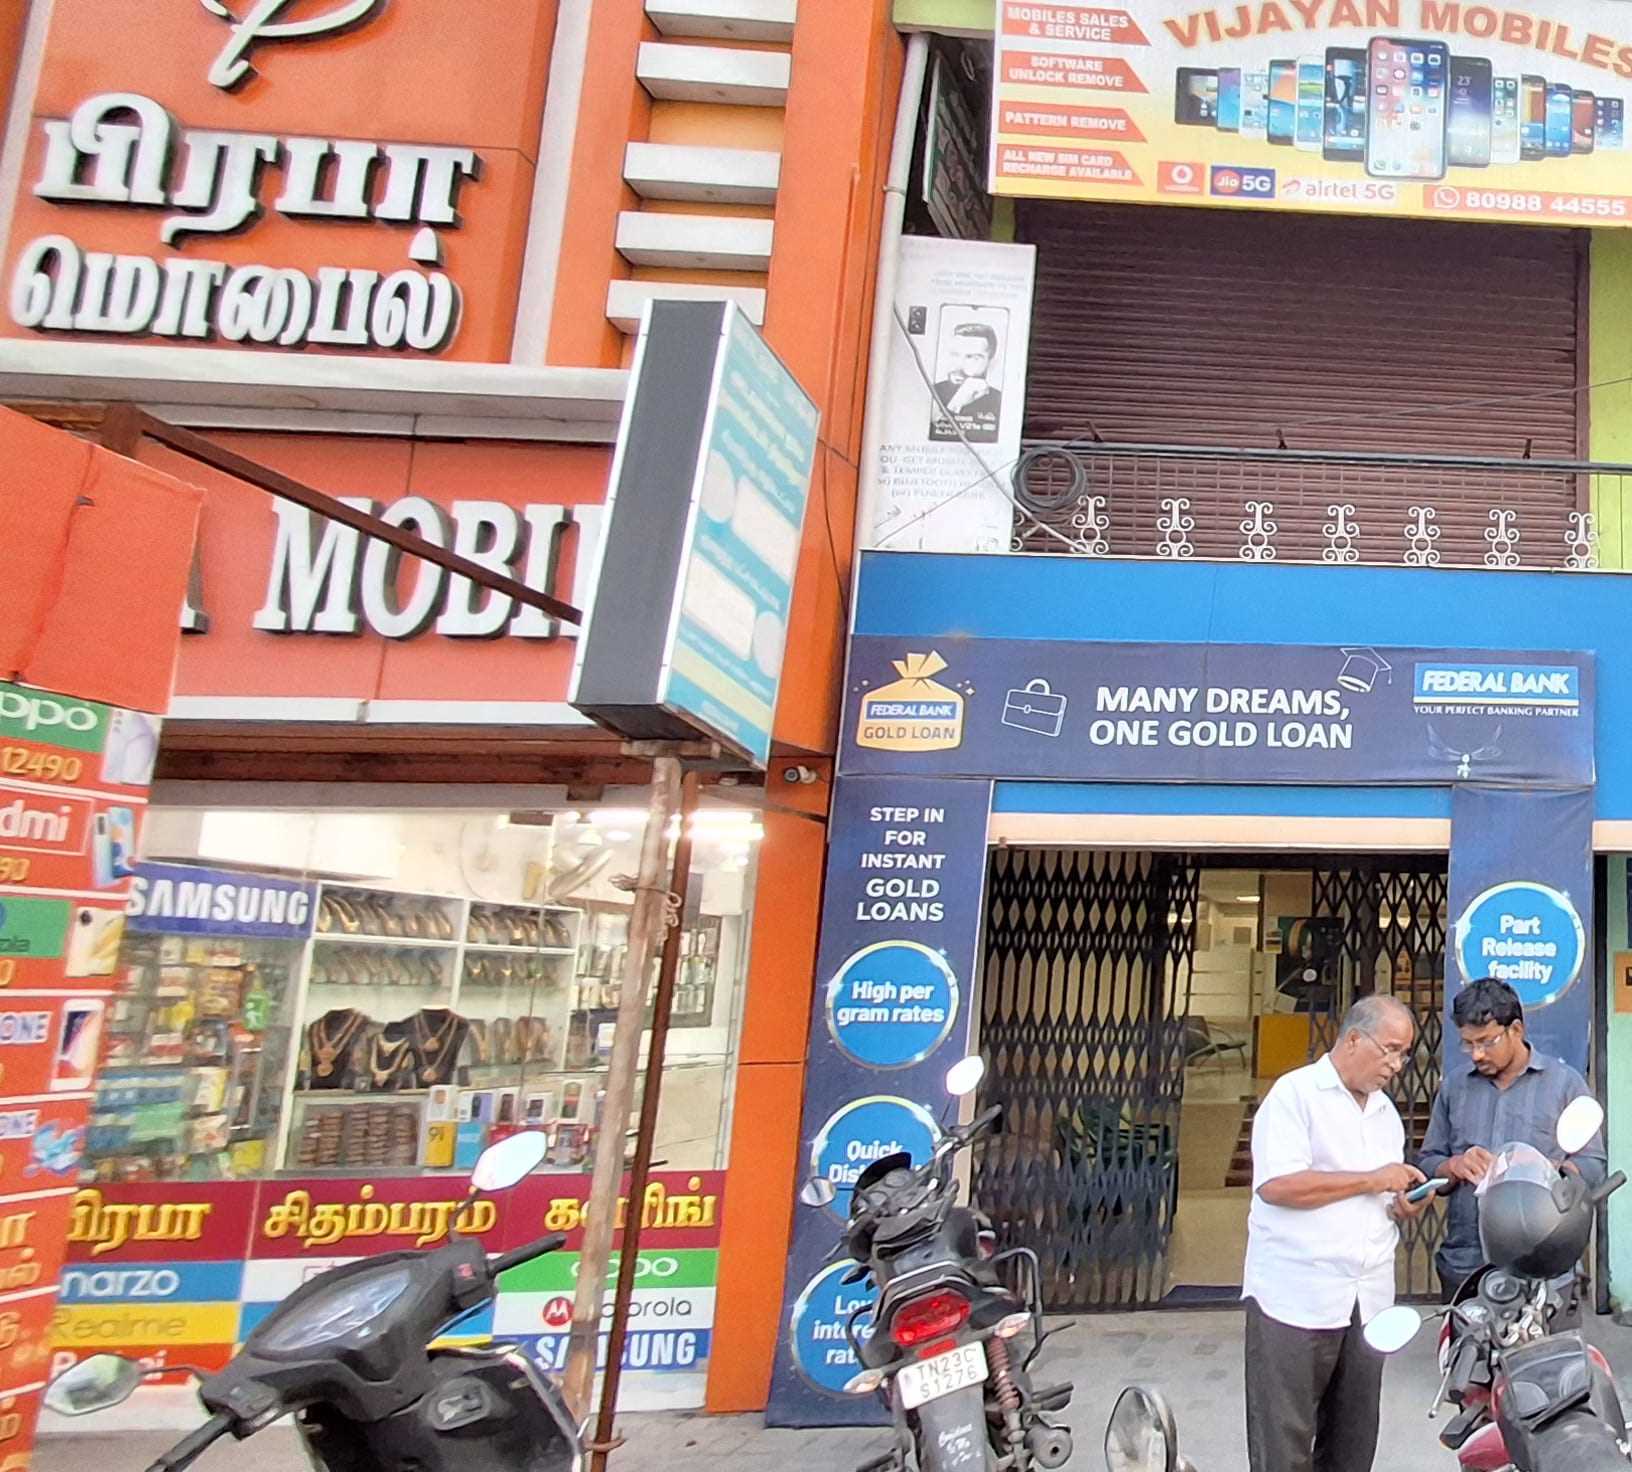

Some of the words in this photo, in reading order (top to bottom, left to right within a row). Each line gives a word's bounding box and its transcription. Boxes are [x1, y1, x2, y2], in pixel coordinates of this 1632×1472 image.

[1007, 6, 1076, 26] MOBILES
[1079, 11, 1129, 29] SALES
[1163, 0, 1400, 48] VIJAYAN
[1030, 24, 1040, 36] &
[1045, 25, 1111, 41] SERVICE
[1031, 56, 1103, 72] SOFTWARE
[1009, 67, 1066, 85] UNLOCK
[1069, 71, 1124, 88] REMOVE
[1006, 111, 1068, 129] PATTERN
[1071, 114, 1126, 131] REMOVE
[33, 93, 478, 244] பிரபா
[1242, 174, 1271, 193] 5G
[1305, 179, 1359, 198] airtel
[1363, 182, 1395, 200] 5G
[1466, 191, 1542, 211] 80988
[1551, 195, 1625, 217] 44555
[11, 228, 461, 351] மொபைல்
[1422, 669, 1507, 692] FEDERAL
[1510, 671, 1570, 695] BANK
[870, 703, 918, 719] FEDERAL
[920, 704, 954, 721] BANK
[1096, 685, 1198, 714] MANY
[1205, 688, 1350, 720] DREAMS,
[1413, 704, 1440, 716] YOUR
[1442, 704, 1481, 717] PERFECT
[1485, 705, 1531, 718] BANKING
[1534, 705, 1579, 718] PARTNER
[863, 724, 905, 742] GOLD
[911, 724, 955, 742] LOAN
[1089, 720, 1159, 747] ONE
[1167, 721, 1259, 748] GOLD
[1267, 722, 1353, 749] LOAN
[870, 807, 918, 822] STEP
[924, 807, 944, 823] IN
[884, 831, 926, 846] FOR
[861, 854, 945, 869] INSTANT
[866, 879, 940, 898] GOLD
[128, 879, 309, 926] SAMSUNG
[856, 902, 944, 921] LOANS
[1500, 915, 1541, 935] Part
[1482, 938, 1557, 958] Release
[1488, 961, 1552, 985] facility
[852, 981, 898, 1003] High
[900, 984, 934, 1003] per
[837, 1008, 888, 1025] gram
[892, 1006, 945, 1023] rates
[847, 1141, 903, 1160] Quick
[61, 1267, 180, 1298] narzo
